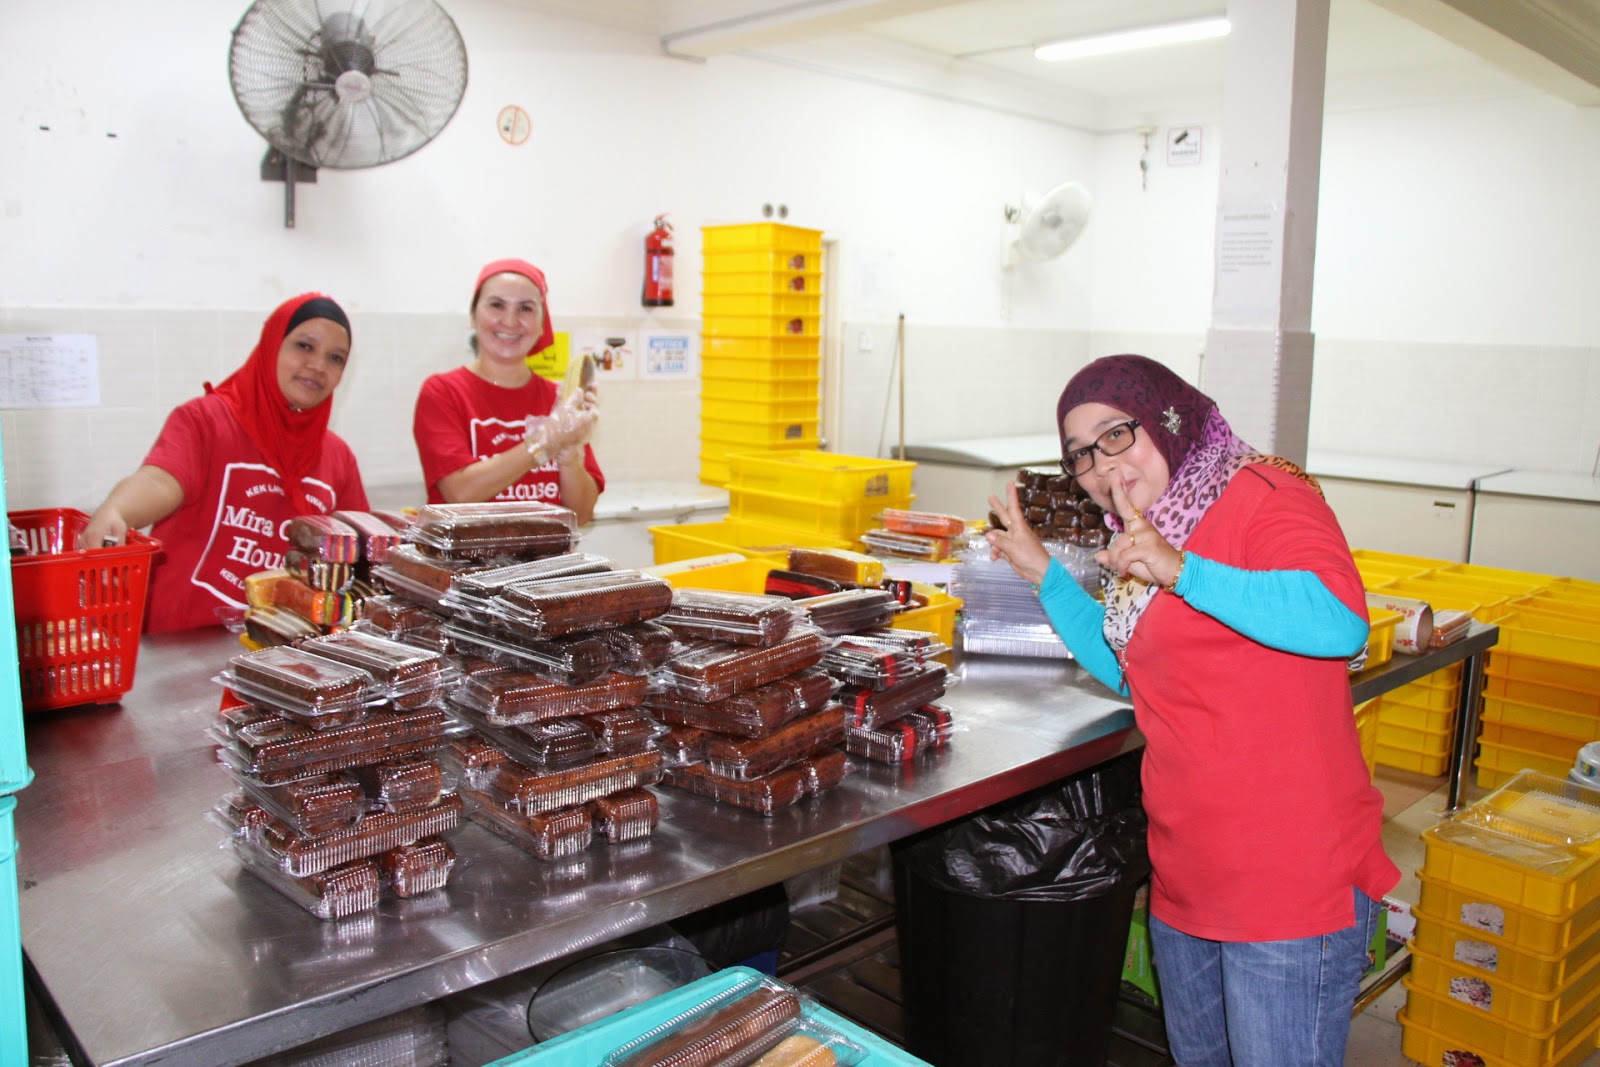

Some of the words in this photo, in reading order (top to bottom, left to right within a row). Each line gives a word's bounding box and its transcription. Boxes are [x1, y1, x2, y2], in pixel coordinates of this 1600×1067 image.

[245, 484, 267, 498] KEK
[221, 505, 275, 538] Mira
[226, 536, 287, 571] Hou
[219, 567, 241, 587] KEK
